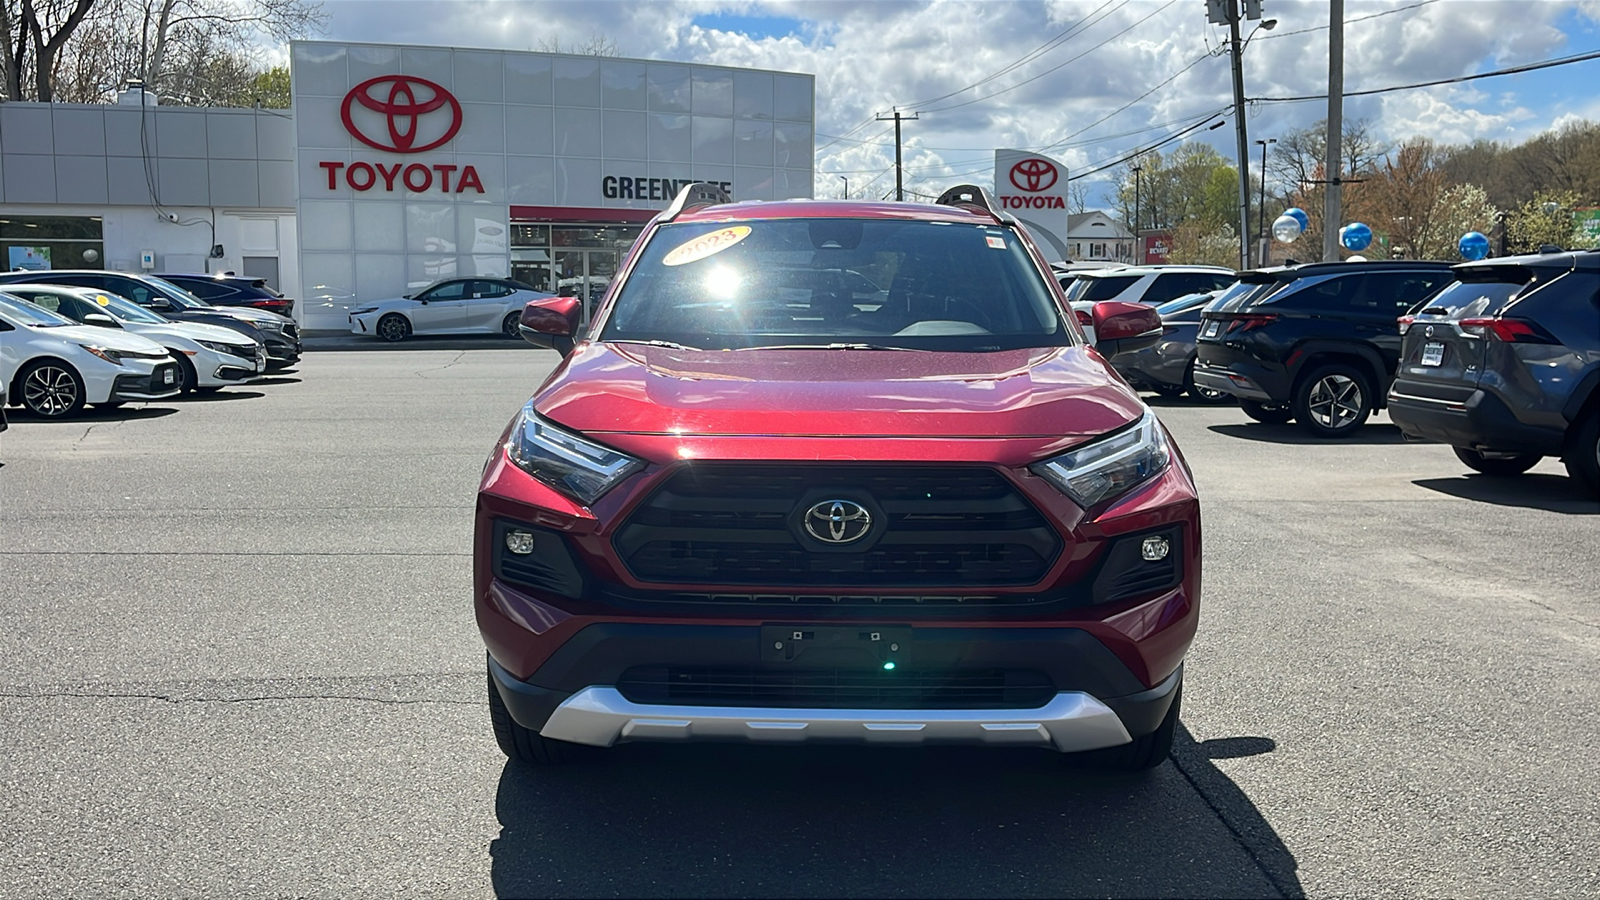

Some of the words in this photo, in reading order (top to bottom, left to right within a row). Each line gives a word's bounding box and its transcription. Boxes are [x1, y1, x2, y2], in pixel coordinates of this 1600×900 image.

[319, 161, 485, 194] TOYOTA
[602, 175, 732, 201] GREENTE
[1000, 196, 1065, 209] TOYOTA
[681, 229, 737, 258] 2023
